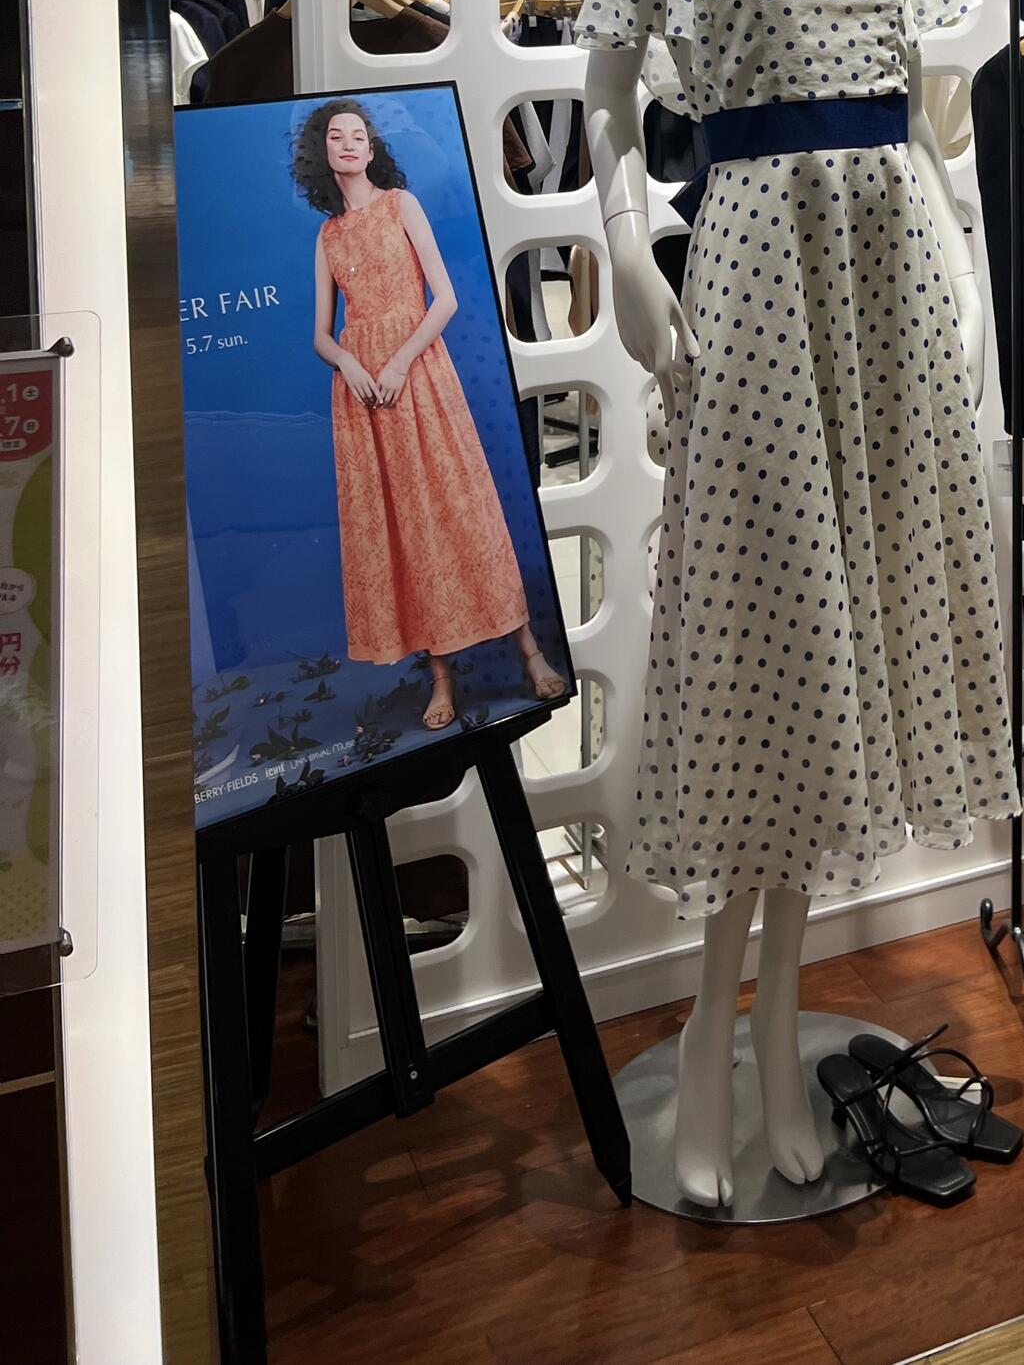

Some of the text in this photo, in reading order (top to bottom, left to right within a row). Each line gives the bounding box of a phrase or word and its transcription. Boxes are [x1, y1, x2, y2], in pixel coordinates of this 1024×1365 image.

[218, 285, 281, 315] FAIR
[186, 334, 249, 355] 5.7 sun.
